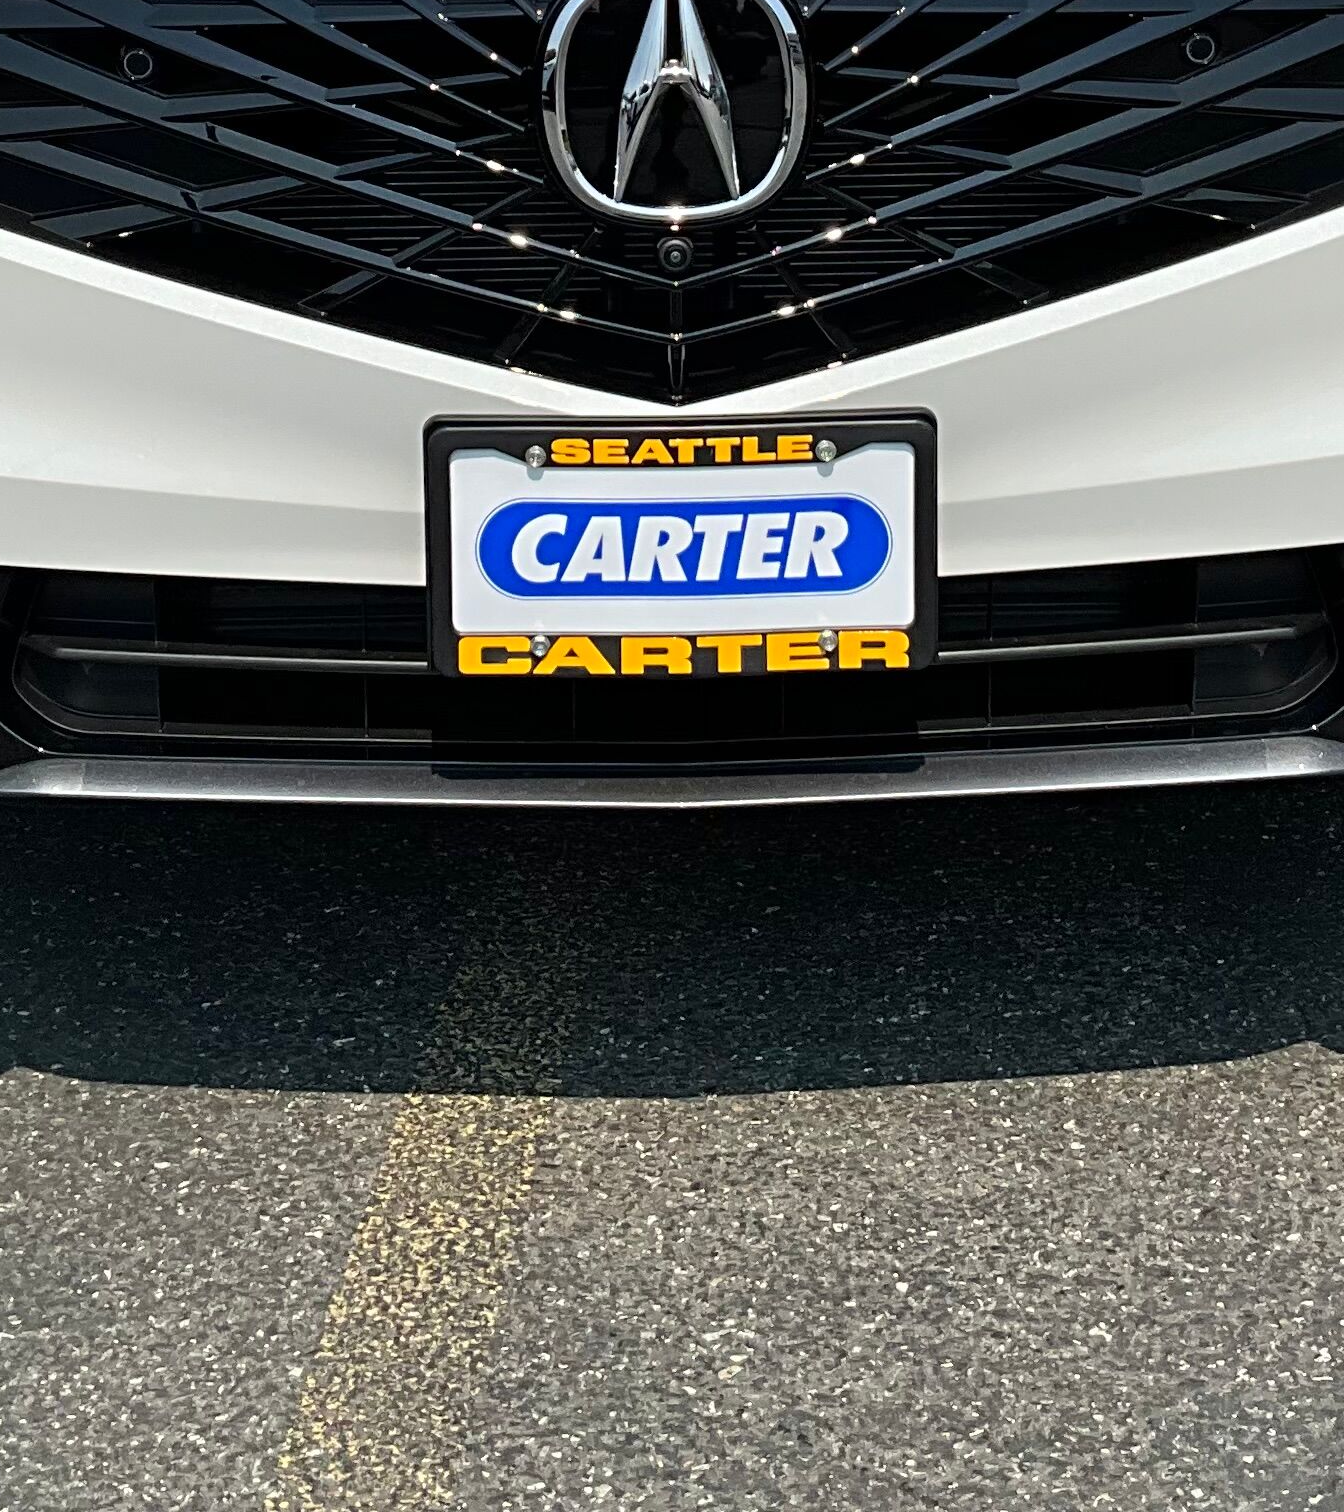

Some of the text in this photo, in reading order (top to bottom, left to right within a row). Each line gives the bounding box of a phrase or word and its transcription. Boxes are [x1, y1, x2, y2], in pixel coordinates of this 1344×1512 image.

[550, 435, 813, 465] SEATTLE
[511, 511, 849, 583] CARTER
[458, 630, 910, 676] CARTER
